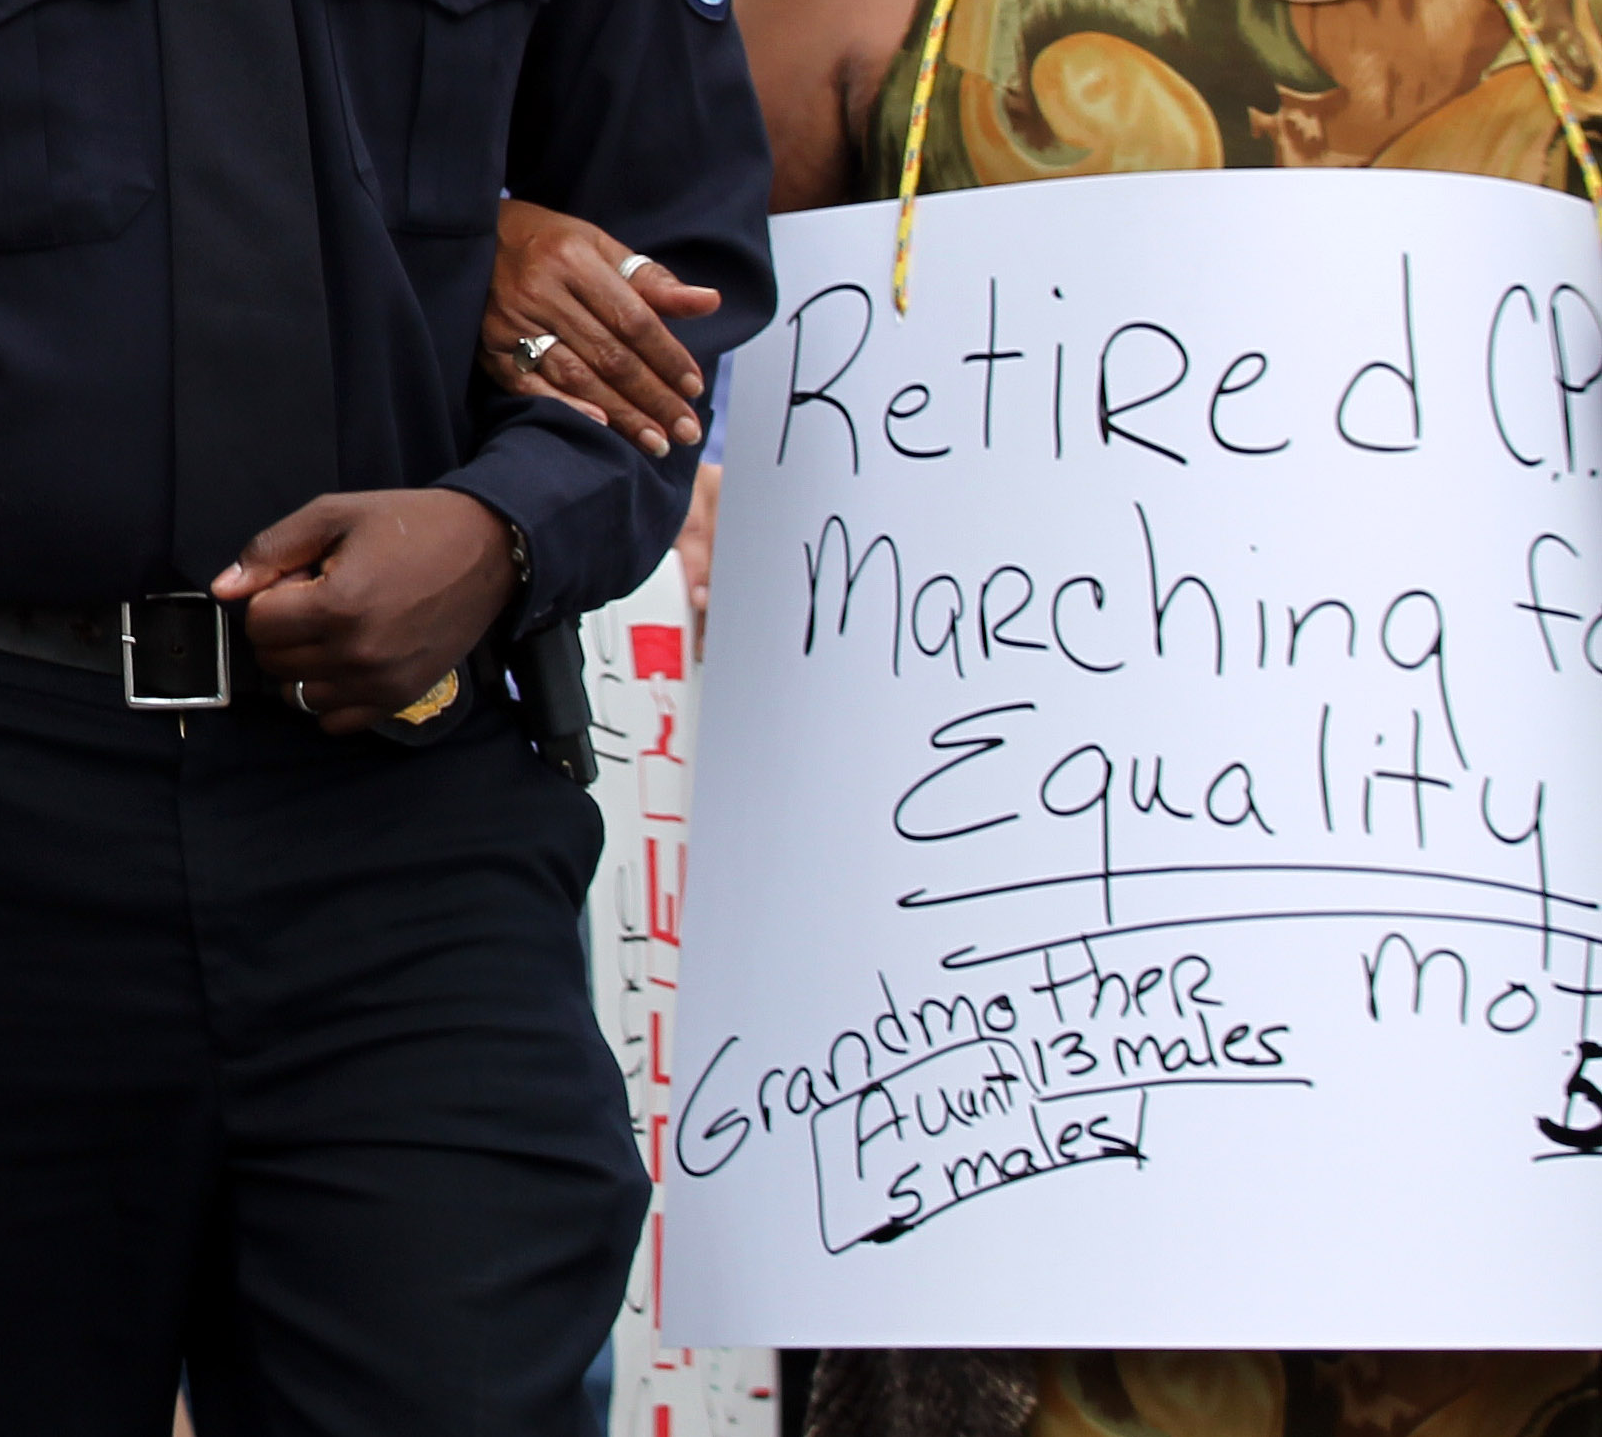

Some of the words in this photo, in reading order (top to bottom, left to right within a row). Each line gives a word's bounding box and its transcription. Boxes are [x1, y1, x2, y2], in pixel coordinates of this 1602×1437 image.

[893, 701, 1549, 970] Equality
[1030, 1030, 1098, 1088] 13
[1113, 1009, 1291, 1078] males
[943, 1103, 1141, 1201] males
